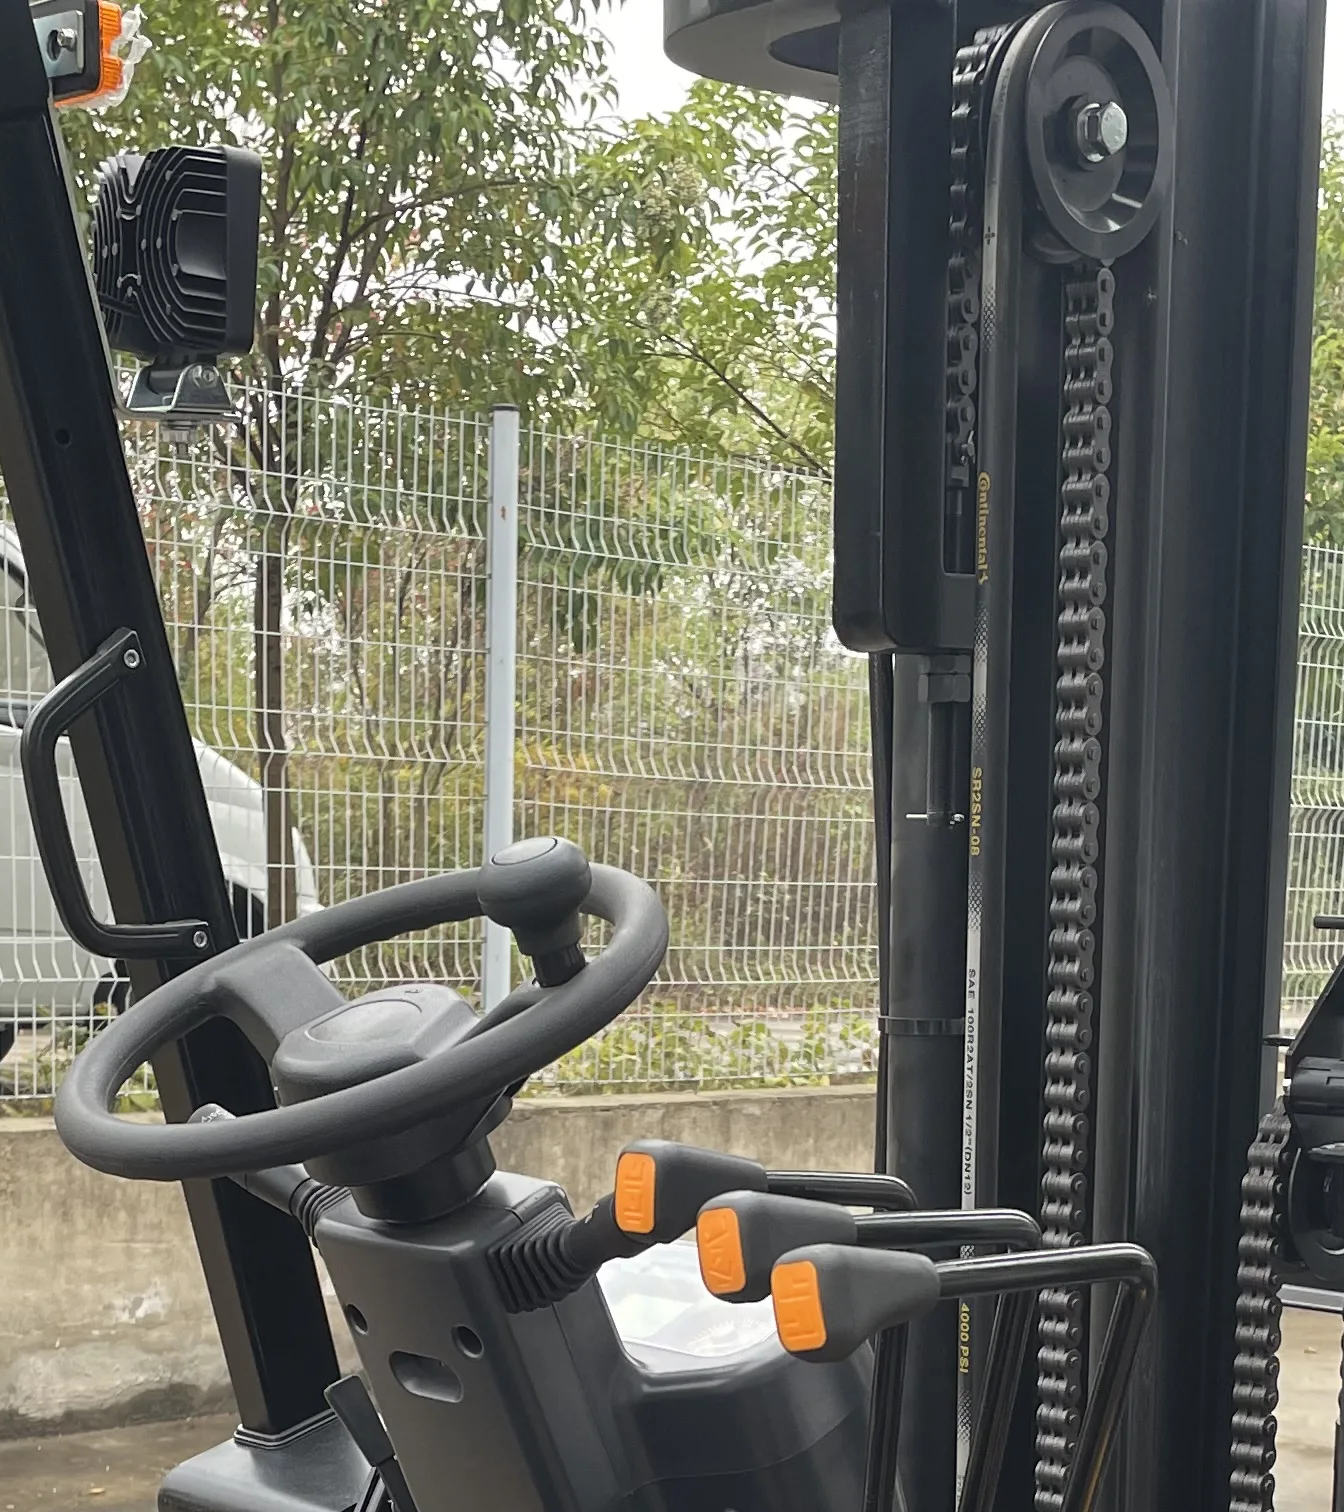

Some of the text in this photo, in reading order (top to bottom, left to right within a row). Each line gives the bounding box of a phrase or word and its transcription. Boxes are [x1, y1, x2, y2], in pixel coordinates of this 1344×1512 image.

[970, 471, 991, 856] Continental SR2SN-08
[968, 969, 976, 1000] SAE
[959, 1303, 970, 1373] 4000 PSI
